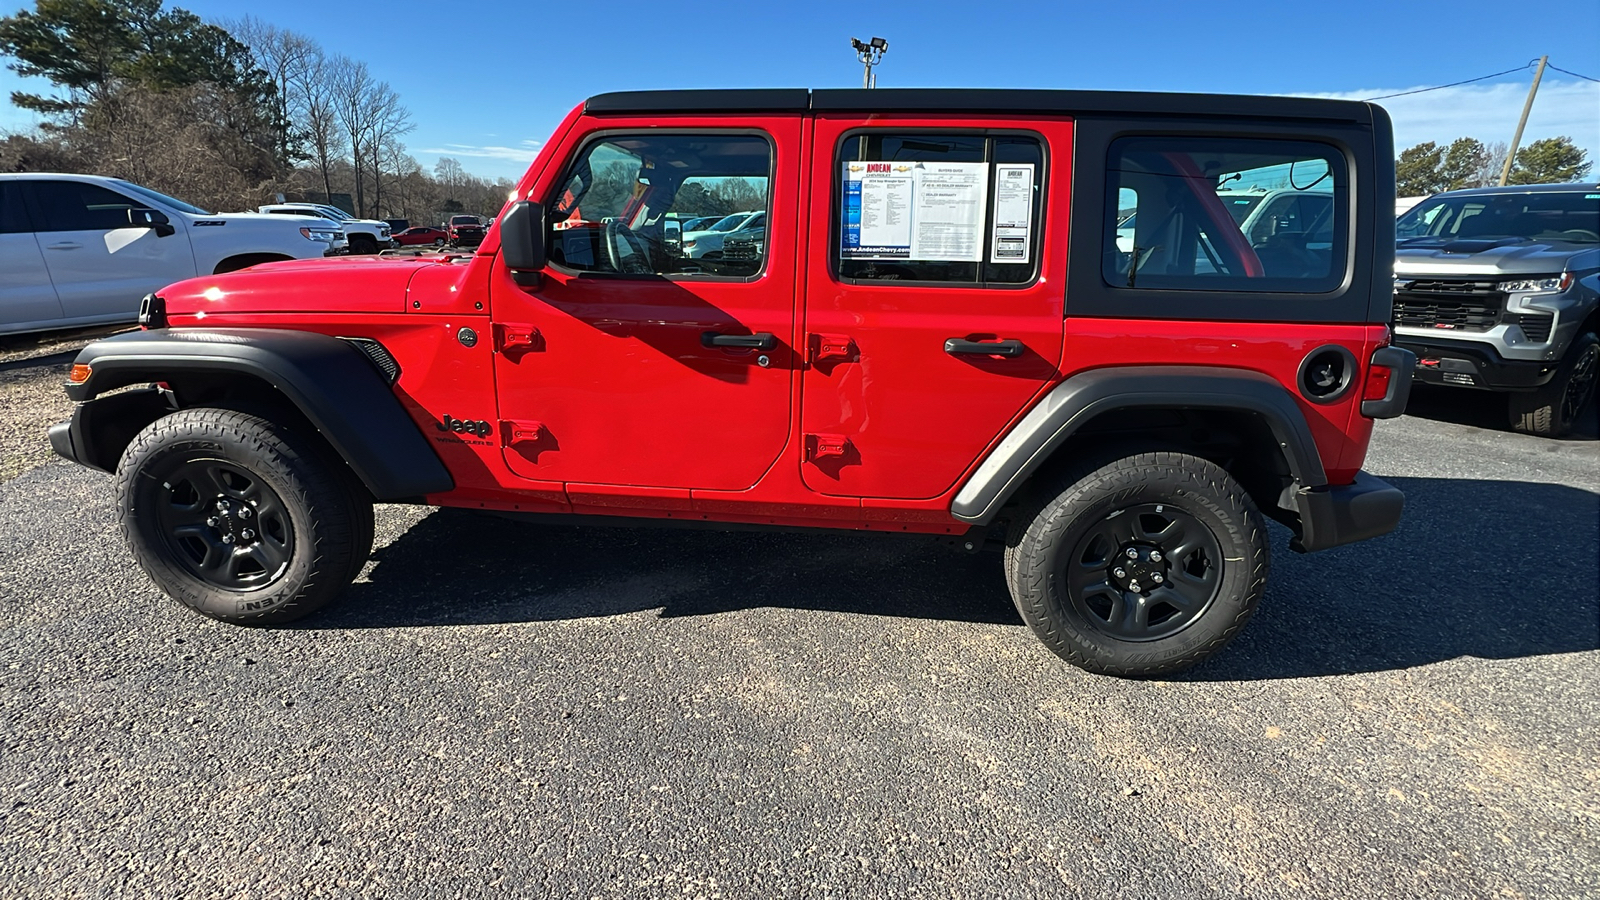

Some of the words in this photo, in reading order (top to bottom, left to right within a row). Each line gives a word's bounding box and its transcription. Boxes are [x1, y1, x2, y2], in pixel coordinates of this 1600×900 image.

[867, 163, 891, 173] ANDEAN
[436, 413, 489, 439] Jeep
[436, 437, 485, 446] WRANGLER
